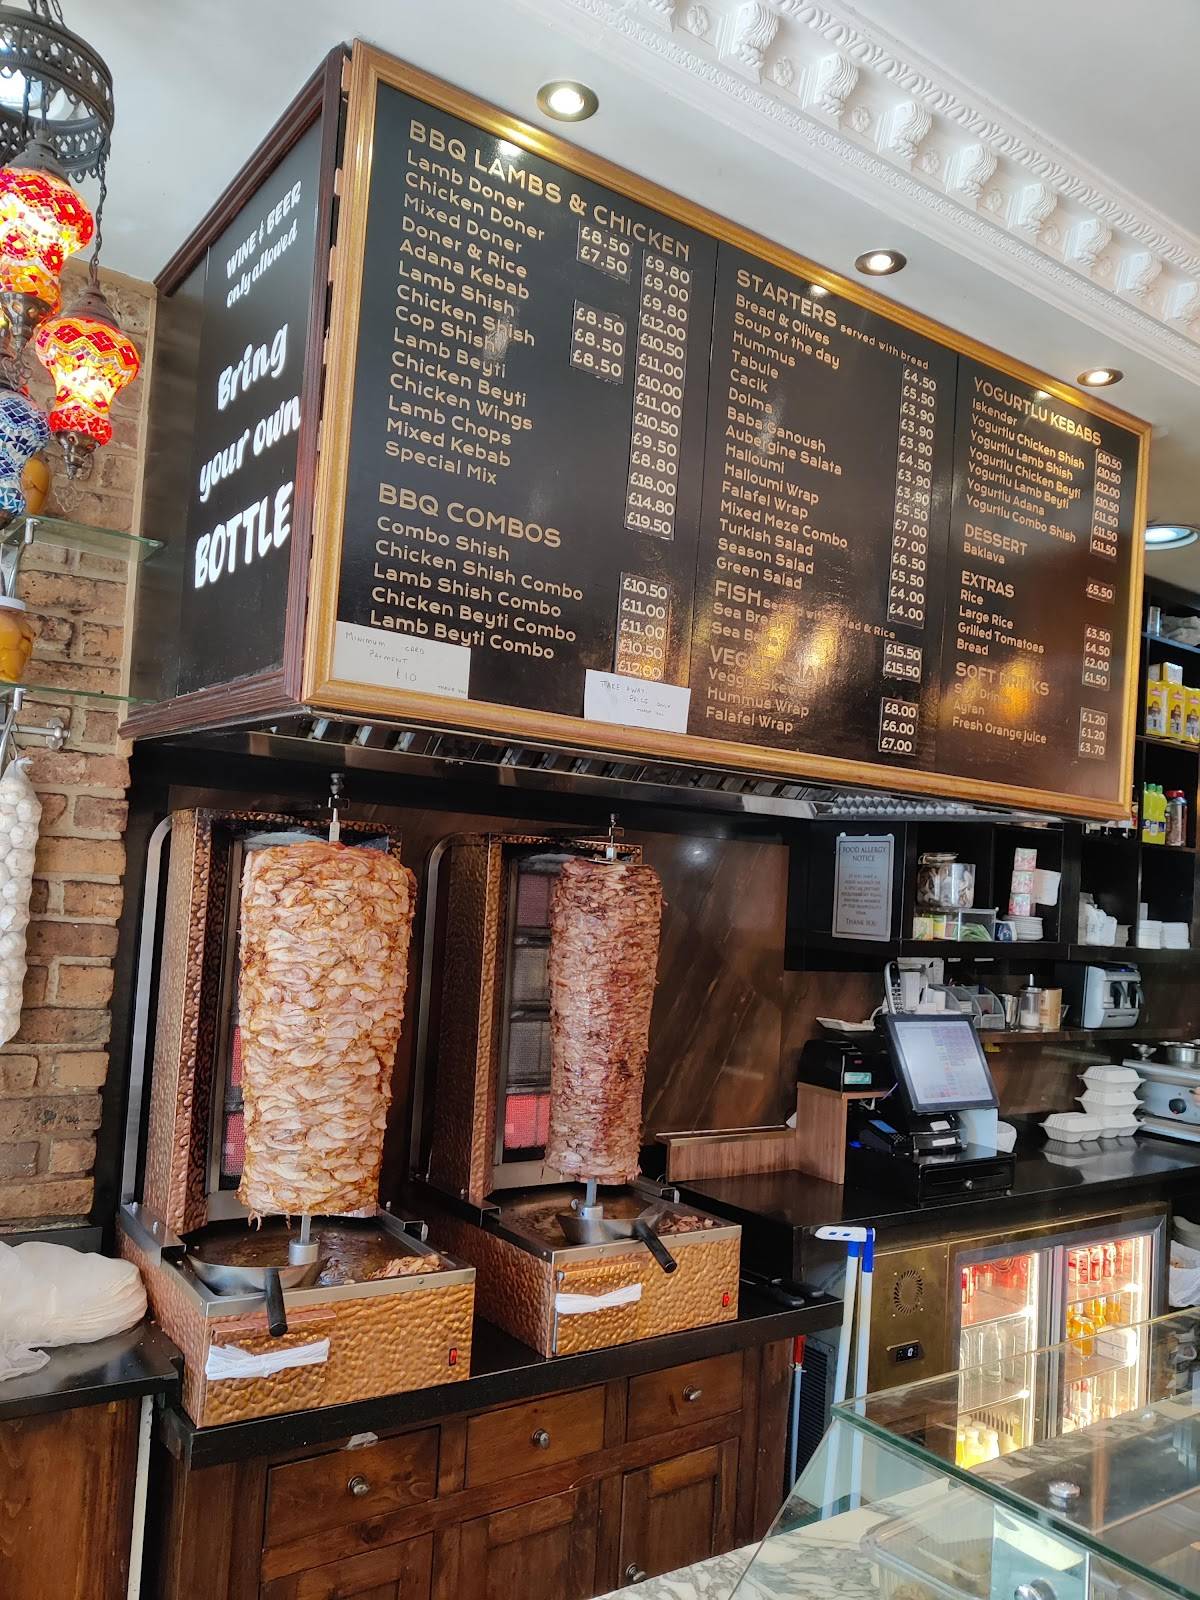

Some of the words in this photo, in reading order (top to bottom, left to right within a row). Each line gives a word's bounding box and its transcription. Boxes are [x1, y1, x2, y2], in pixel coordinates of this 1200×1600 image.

[406, 149, 462, 184] Lamb
[467, 176, 524, 211] Doner
[408, 119, 465, 162] BBQ
[473, 148, 561, 203] LAMBS
[568, 193, 586, 215] &
[592, 205, 689, 261] CHICKEN
[403, 193, 460, 229] Mixed
[465, 219, 521, 253] Doner
[404, 171, 483, 216] Chicken
[489, 206, 544, 240] Doner
[225, 228, 258, 280] WINE
[268, 181, 302, 235] BEER
[401, 215, 461, 251] Doner
[466, 243, 482, 260] &
[486, 250, 526, 277] Rice
[581, 226, 629, 256] £8.50
[226, 273, 251, 309] only
[252, 219, 298, 281] allowed
[398, 238, 463, 274] Adana
[469, 264, 529, 299] Kebab
[579, 245, 627, 274] £7.50
[644, 255, 689, 283] £9.80
[396, 284, 476, 324] Chicken
[398, 260, 455, 293] Lamb
[460, 284, 514, 316] Shish
[643, 273, 688, 302] £9.00
[735, 269, 836, 327] STARTERS
[575, 307, 624, 335] £8.50
[641, 294, 687, 321] £9.80
[735, 293, 775, 321] Bread
[777, 313, 789, 327] &
[791, 319, 829, 345] Olives
[394, 305, 434, 332] Cop
[439, 321, 494, 352] Shish
[573, 328, 622, 356] £8.50
[638, 332, 683, 359] £10.50
[640, 313, 685, 341] £12.00
[733, 311, 770, 337] Soup
[773, 331, 788, 344] of
[790, 336, 812, 354] the
[814, 348, 839, 369] day
[393, 327, 450, 358] Lamb
[455, 348, 505, 378] Beyti
[571, 349, 621, 376] £8.50
[730, 349, 778, 378] Tabule
[732, 330, 795, 366] Hummus
[839, 324, 875, 345] served
[877, 341, 898, 356] with
[899, 350, 928, 369] bread
[217, 323, 288, 411] Bring
[391, 351, 471, 389] Chicken
[476, 378, 525, 407] Beyti
[637, 353, 683, 379] £11.00
[729, 368, 767, 393] Cacik
[389, 373, 470, 410] Chicken
[475, 399, 532, 430] Wings
[636, 373, 682, 399] £10.00
[727, 386, 772, 413] Dolma
[387, 394, 445, 424] Lamb
[450, 415, 511, 445] Chops
[634, 392, 681, 418] £11.00
[726, 406, 762, 429] Baba
[971, 397, 1017, 425] Iskender
[973, 376, 1047, 421] YOGURTLU
[1049, 411, 1101, 445] KEBABS
[386, 417, 444, 447] Mixed
[450, 436, 510, 466] Kebab
[633, 412, 678, 437] £10.50
[970, 413, 1014, 440] Yogurtlu
[1015, 433, 1055, 457] Chicken
[1056, 450, 1084, 470] Shish
[199, 428, 249, 502] your
[253, 395, 301, 457] own
[384, 440, 460, 474] Special
[466, 463, 496, 484] Mix
[629, 448, 676, 475] £8.80
[630, 432, 676, 456] £9.50
[724, 424, 796, 459] Aubergine
[798, 450, 841, 475] Salata
[724, 442, 784, 473] Halloumi
[629, 472, 675, 496] £18.00
[723, 462, 783, 492] Halloumi
[785, 482, 818, 505] Wrap
[968, 445, 1012, 472] Yogurtlu
[1013, 464, 1054, 488] Chicken
[1054, 480, 1080, 498] Beyti
[378, 482, 438, 516] BBQ
[446, 502, 560, 547] COMBOS
[627, 492, 674, 515] £14.80
[721, 480, 770, 506] Falafel
[772, 496, 808, 519] Wrap
[966, 477, 1010, 503] Yogurtlu
[1011, 495, 1044, 515] Adana
[194, 481, 294, 589] BOTTLE
[376, 516, 449, 545] Combo
[454, 535, 508, 561] Shish
[626, 511, 671, 534] £19.50
[718, 517, 770, 544] Turkish
[773, 534, 813, 556] Salad
[719, 499, 760, 522] Mixed
[763, 512, 798, 533] Meze
[801, 524, 847, 548] Combo
[963, 523, 1027, 555] DESSERT
[374, 539, 456, 571] Chicken
[461, 560, 515, 585] Shish
[519, 574, 582, 600] Combo
[716, 537, 771, 563] Season
[774, 553, 813, 574] Salad
[962, 541, 1004, 564] Baklava
[373, 562, 431, 588] Lamb
[436, 577, 491, 602] Shish
[496, 591, 561, 617] Combo
[715, 556, 759, 578] Green
[761, 568, 801, 589] Salad
[960, 570, 1014, 597] EXTRAS
[714, 579, 761, 606] FISH
[959, 588, 983, 605] Rice
[371, 586, 453, 616] Chicken
[458, 604, 508, 629] Beyti
[512, 617, 575, 641] Combo
[958, 604, 989, 623] Large
[990, 613, 1013, 629] Rice
[369, 609, 428, 633] Lamb
[433, 622, 484, 646] Beyti
[488, 634, 553, 659] Combo
[955, 637, 988, 655] Bread
[956, 621, 992, 639] Grilled
[993, 630, 1043, 653] Tomatoes
[954, 661, 995, 682] SOFT
[704, 705, 754, 725] Falafel
[757, 715, 793, 734] Wrap
[706, 686, 771, 709] Hummus
[774, 699, 809, 718] Wrap
[951, 716, 982, 731] Fresh
[983, 722, 1021, 740] Orange
